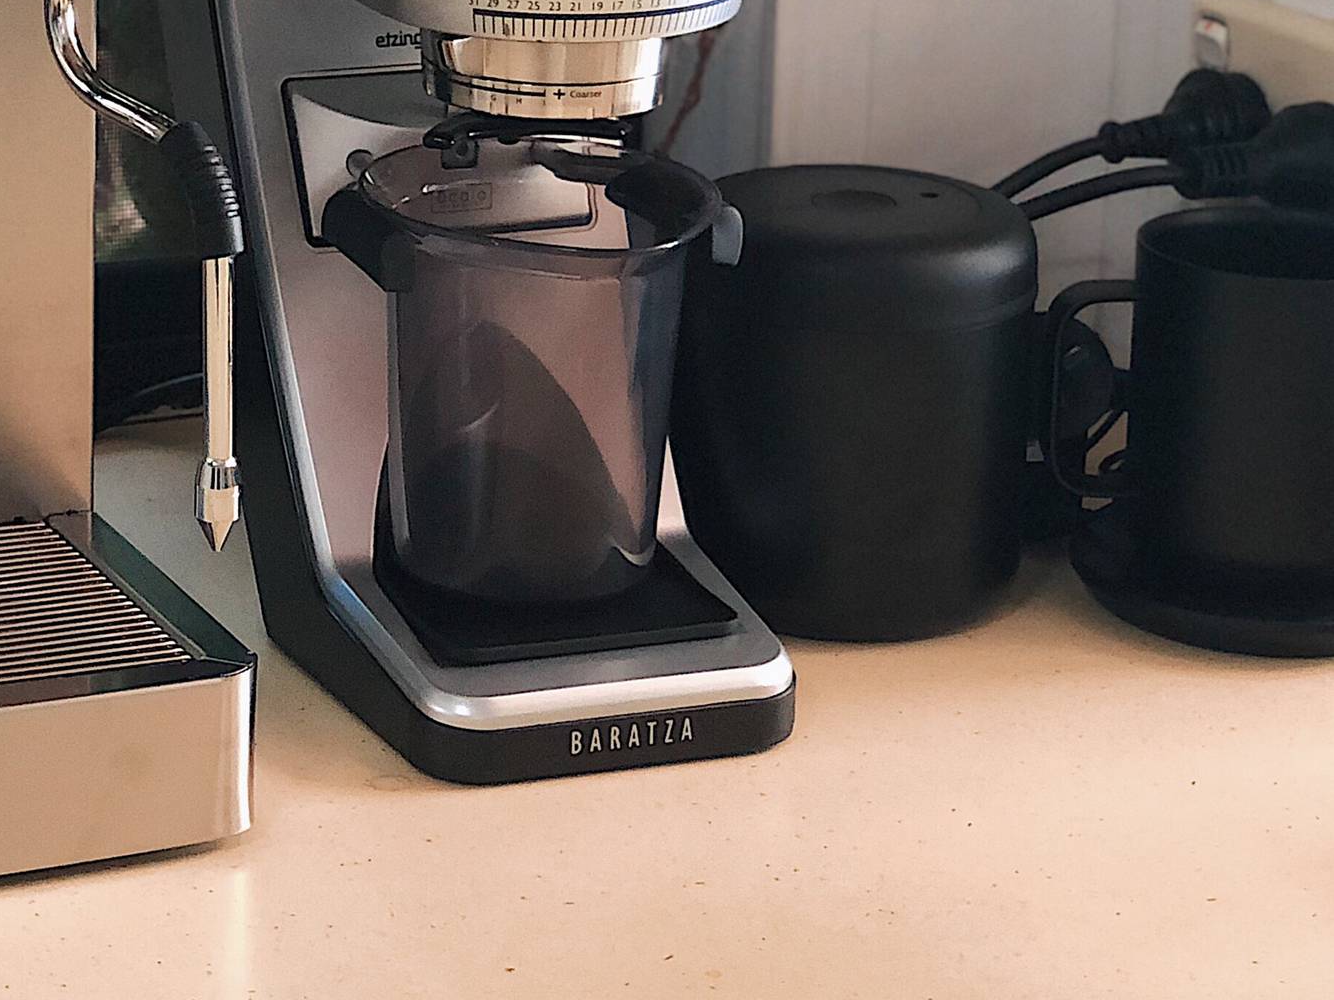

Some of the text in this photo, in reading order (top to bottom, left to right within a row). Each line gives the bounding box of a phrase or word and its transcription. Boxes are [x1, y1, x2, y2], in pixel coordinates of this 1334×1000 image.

[506, 0, 520, 10] 27
[527, 0, 541, 11] 25
[548, 1, 562, 12] 23
[570, 2, 581, 11] 21
[591, 1, 604, 11] 19
[612, 1, 624, 10] 17
[631, 0, 643, 9] 15
[569, 90, 602, 99] Coarser
[570, 717, 693, 755] BARATZA
